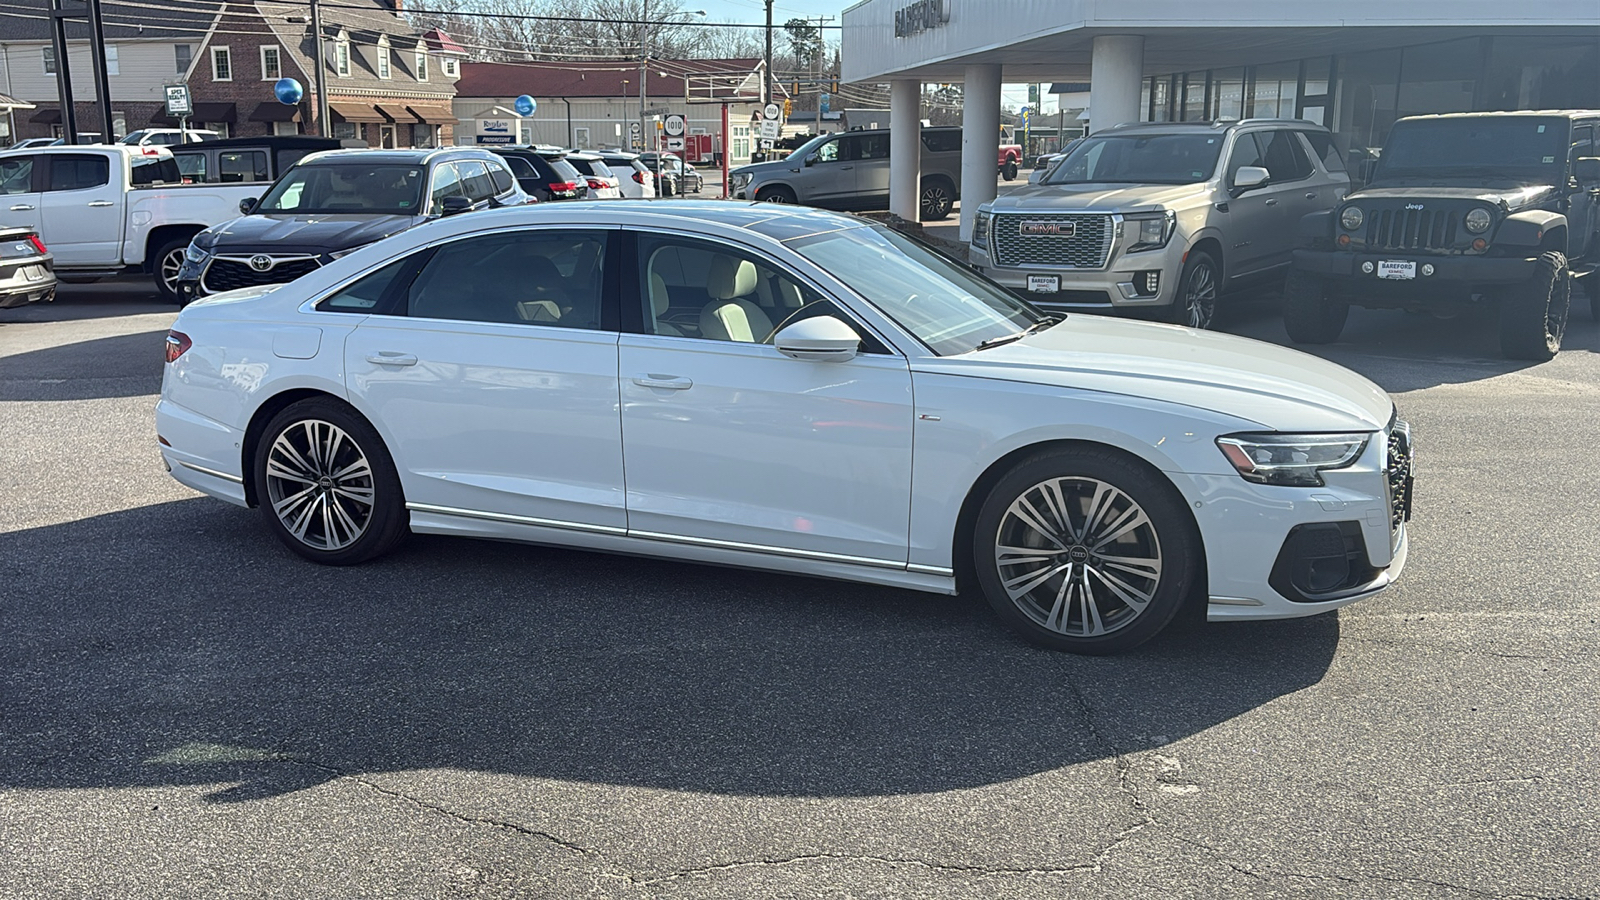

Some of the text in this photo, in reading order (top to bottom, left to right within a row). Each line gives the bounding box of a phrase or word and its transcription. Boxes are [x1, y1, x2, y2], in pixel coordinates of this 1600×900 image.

[667, 121, 682, 130] 1010
[1405, 202, 1424, 211] Jeep
[1022, 223, 1073, 235] GMC
